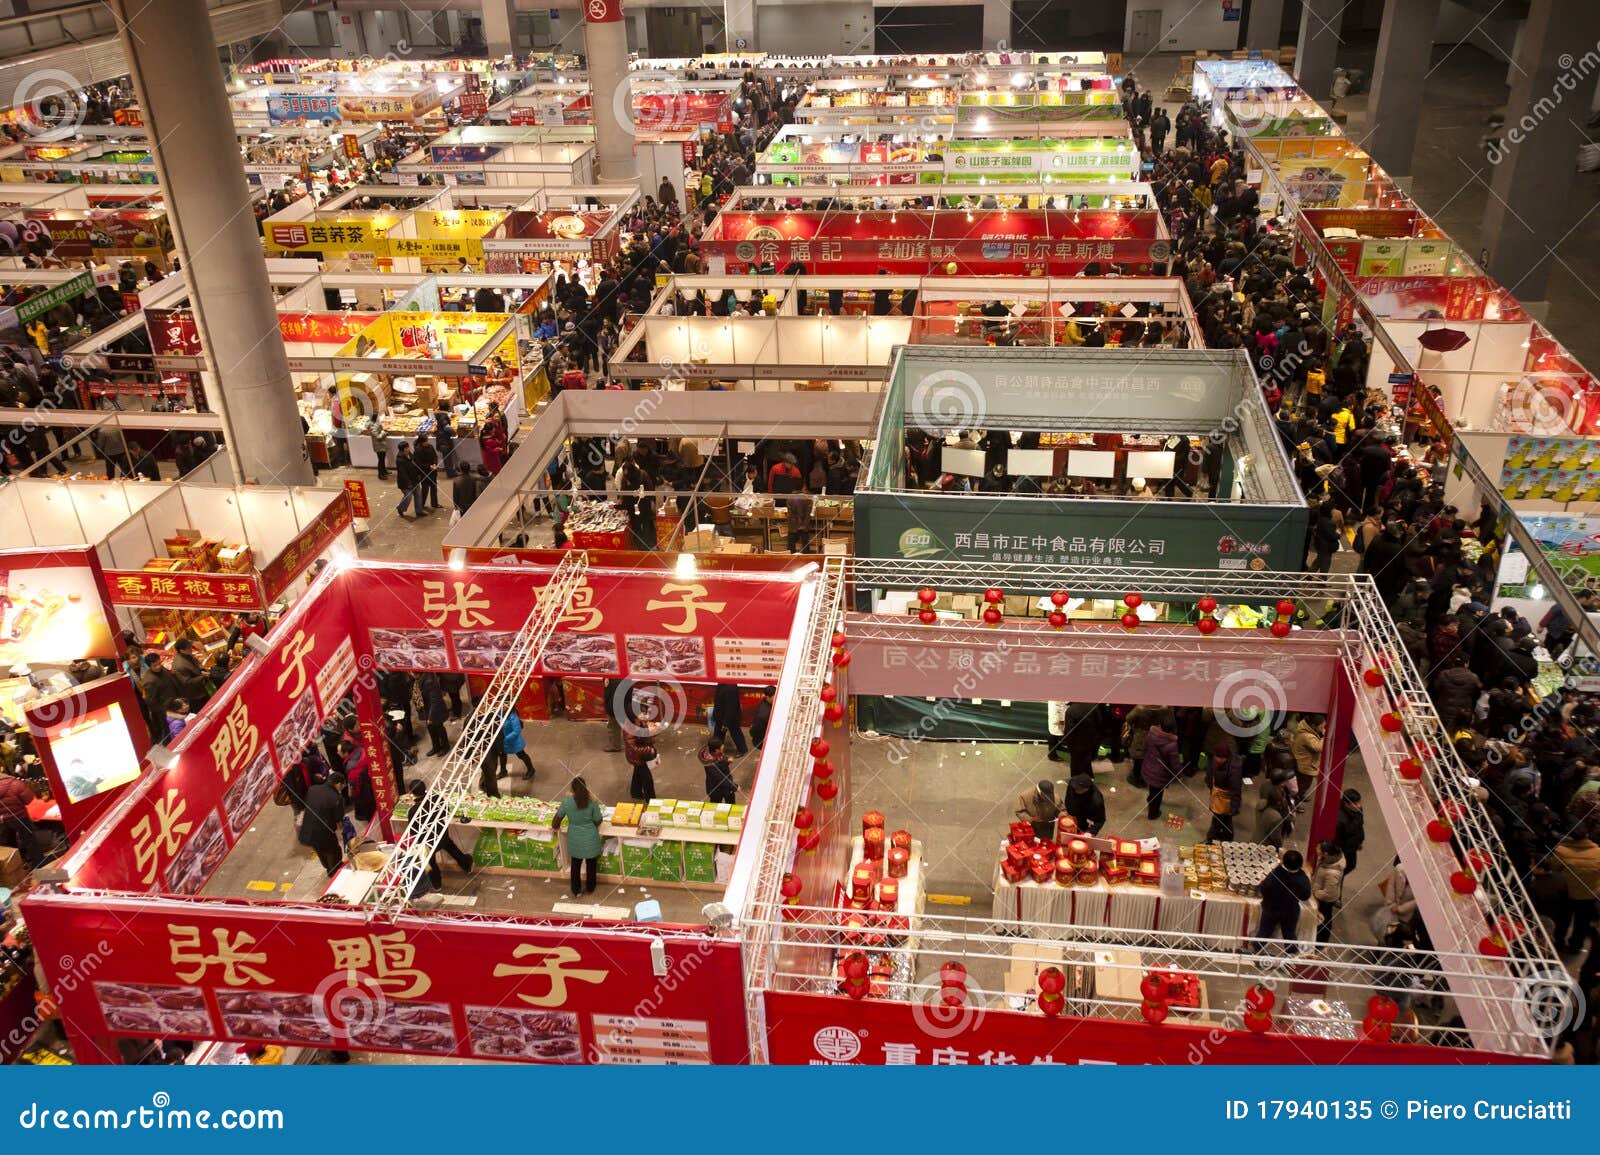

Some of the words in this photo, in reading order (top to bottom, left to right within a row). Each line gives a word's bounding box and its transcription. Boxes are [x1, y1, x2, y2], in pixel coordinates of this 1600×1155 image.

[309, 227, 364, 244] 苦荞茶
[760, 242, 842, 262] 徐福記
[1012, 242, 1116, 260] 阿尔卑斯糖
[953, 532, 1166, 556] 西昌市正中食品有限公司
[117, 576, 216, 595] 香脆椒
[422, 579, 727, 633] 张鸭子
[130, 629, 315, 885] 张鸭子
[167, 923, 610, 1008] 张鸭子
